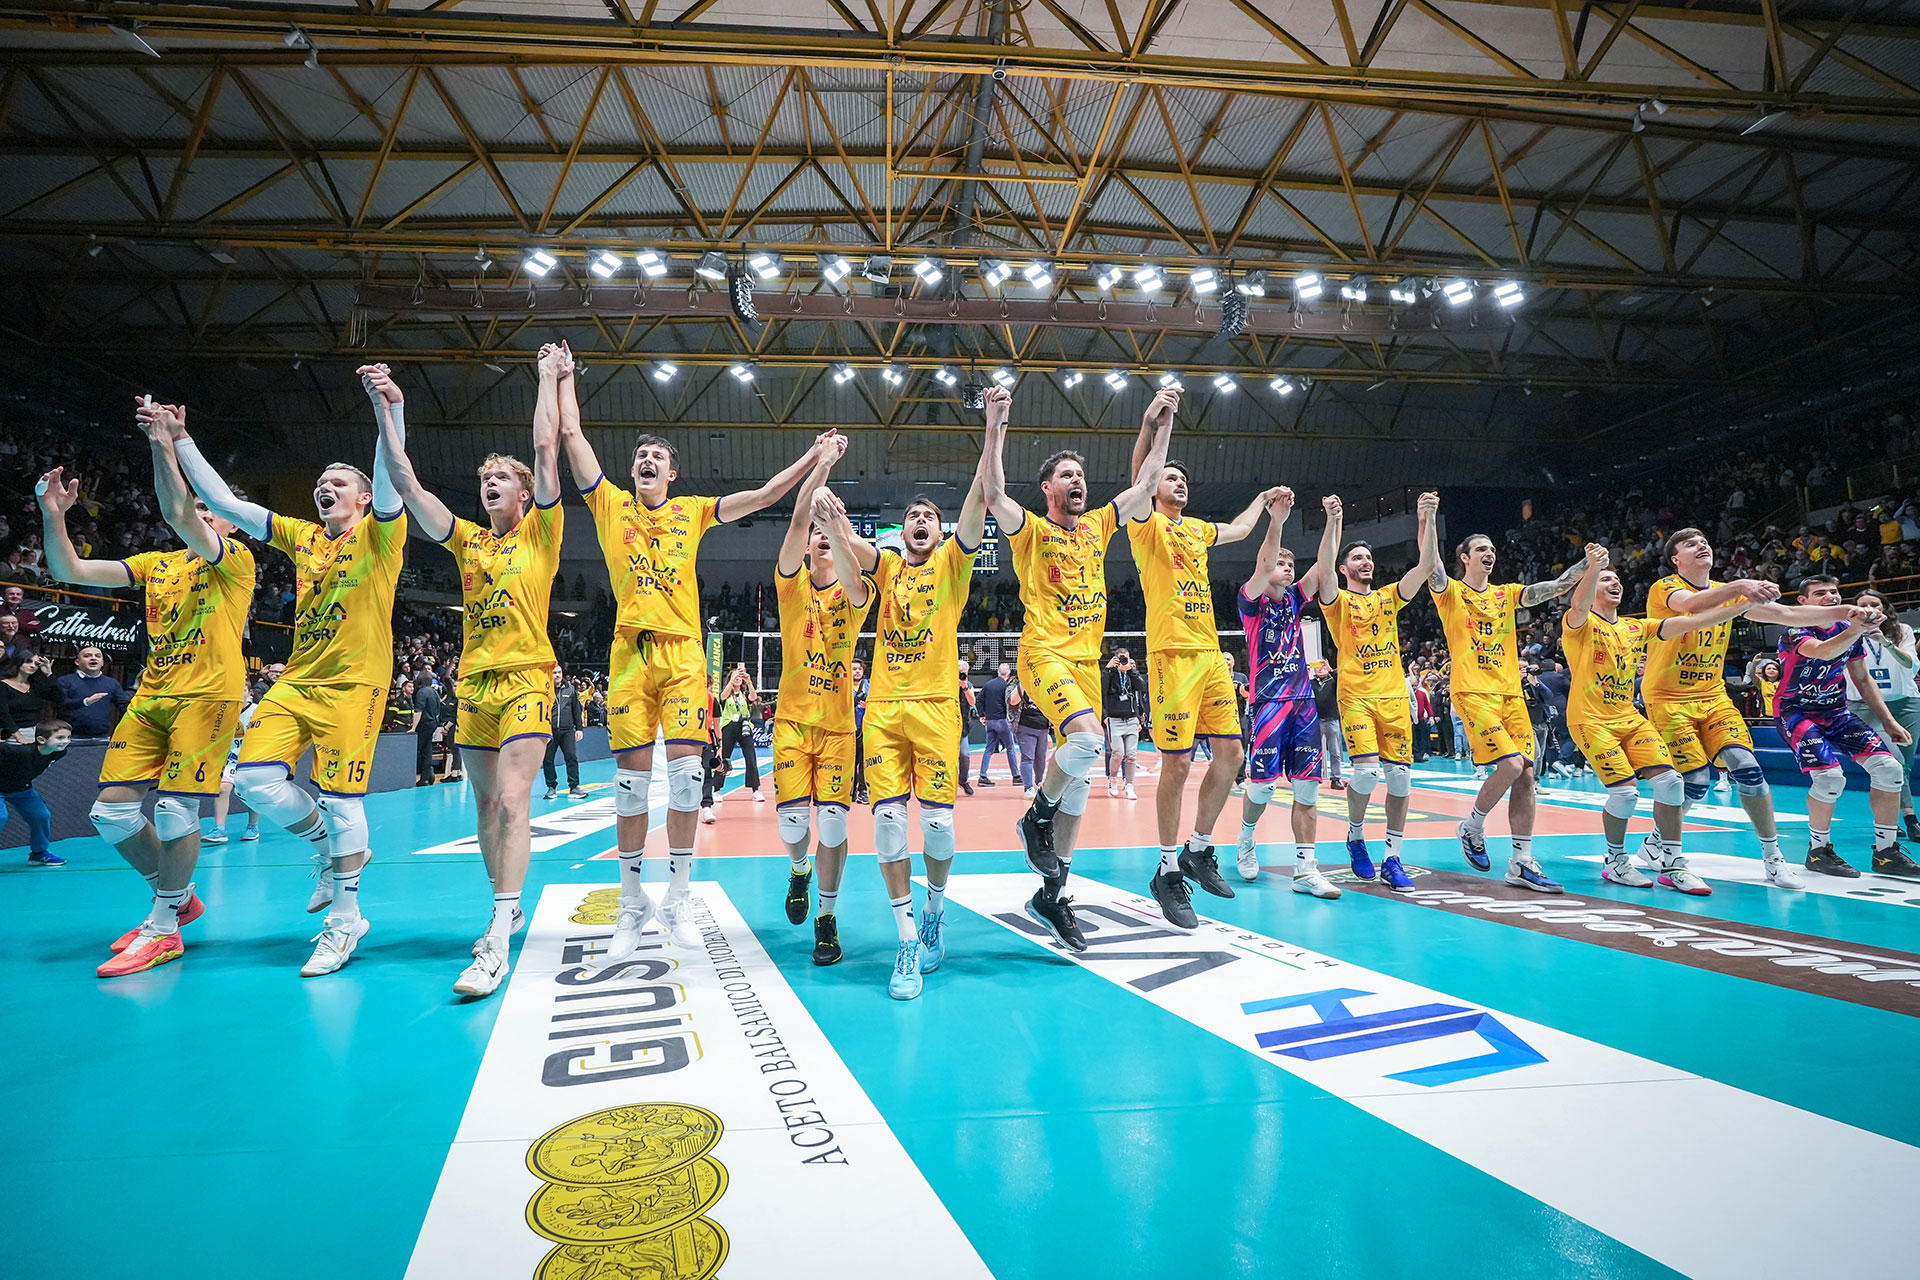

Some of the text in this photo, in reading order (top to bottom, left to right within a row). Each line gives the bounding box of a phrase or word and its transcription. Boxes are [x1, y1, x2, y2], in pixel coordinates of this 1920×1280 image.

[917, 583, 935, 594] VEM
[1057, 591, 1108, 605] VALSA
[148, 628, 205, 645] VALSA
[883, 628, 934, 642] VALSA
[1371, 622, 1380, 637] 8
[1698, 630, 1713, 647] 12
[712, 637, 722, 668] BANCA
[1356, 641, 1397, 654] VALSA
[156, 653, 197, 667] BPER:
[886, 651, 926, 663] BPER:
[1677, 652, 1722, 664] VALSA
[1363, 659, 1393, 671] BPER:
[195, 761, 206, 783] 6
[347, 760, 367, 783] 15
[699, 924, 740, 964] MODENA
[715, 966, 746, 980] DI
[541, 928, 704, 1088] GIUSTI
[722, 982, 798, 1075] BALSAMICO
[769, 1079, 850, 1166] ACETO
